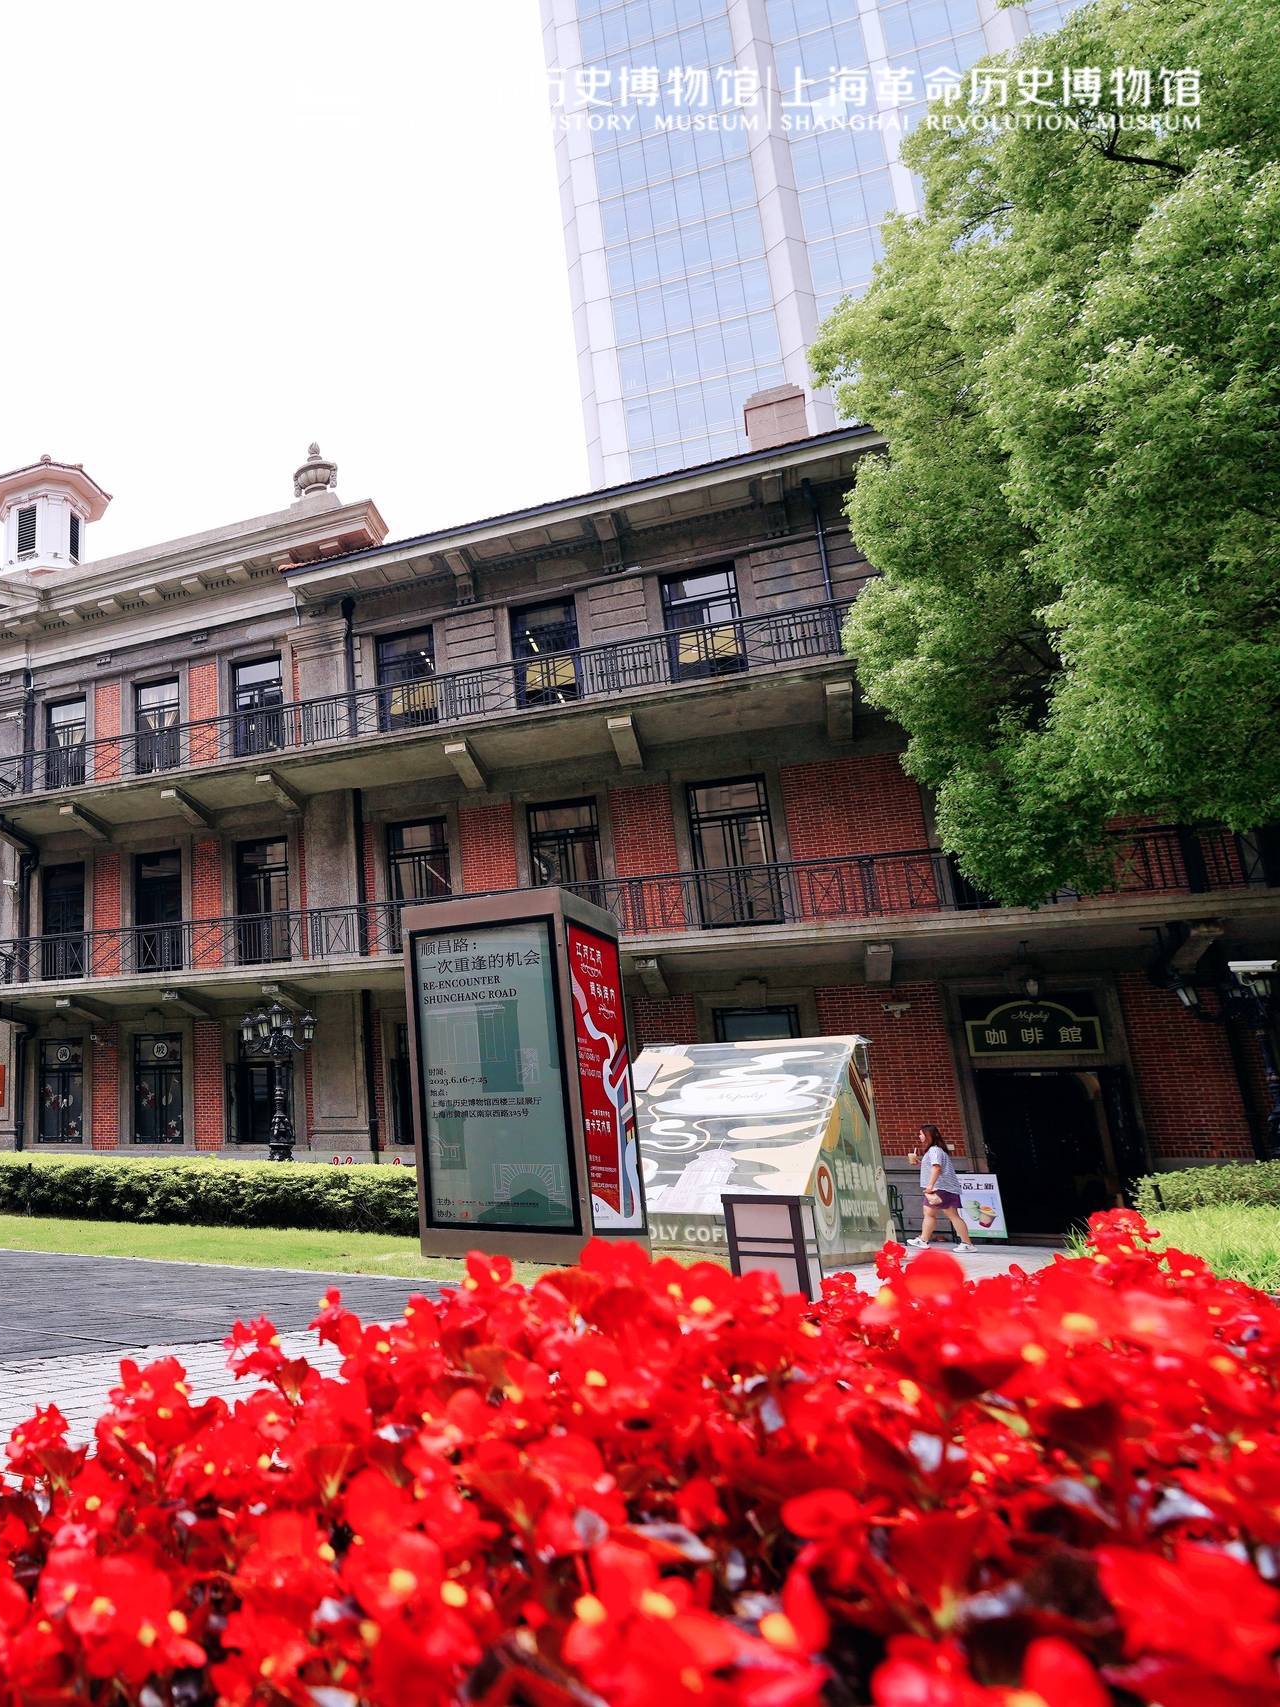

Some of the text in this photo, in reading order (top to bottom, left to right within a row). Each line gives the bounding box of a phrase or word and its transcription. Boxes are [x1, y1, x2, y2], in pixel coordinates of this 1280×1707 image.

[422, 949, 540, 974] 一次重逢的机会
[423, 975, 501, 991] RE-ENCOUNTER
[423, 988, 517, 1005] SHUNCHANG ROAD
[985, 1026, 1083, 1046] 咖啡館
[430, 1076, 488, 1085] 2023.6.16-7.25
[959, 1182, 995, 1190] 品上新
[684, 1225, 728, 1242] COF
